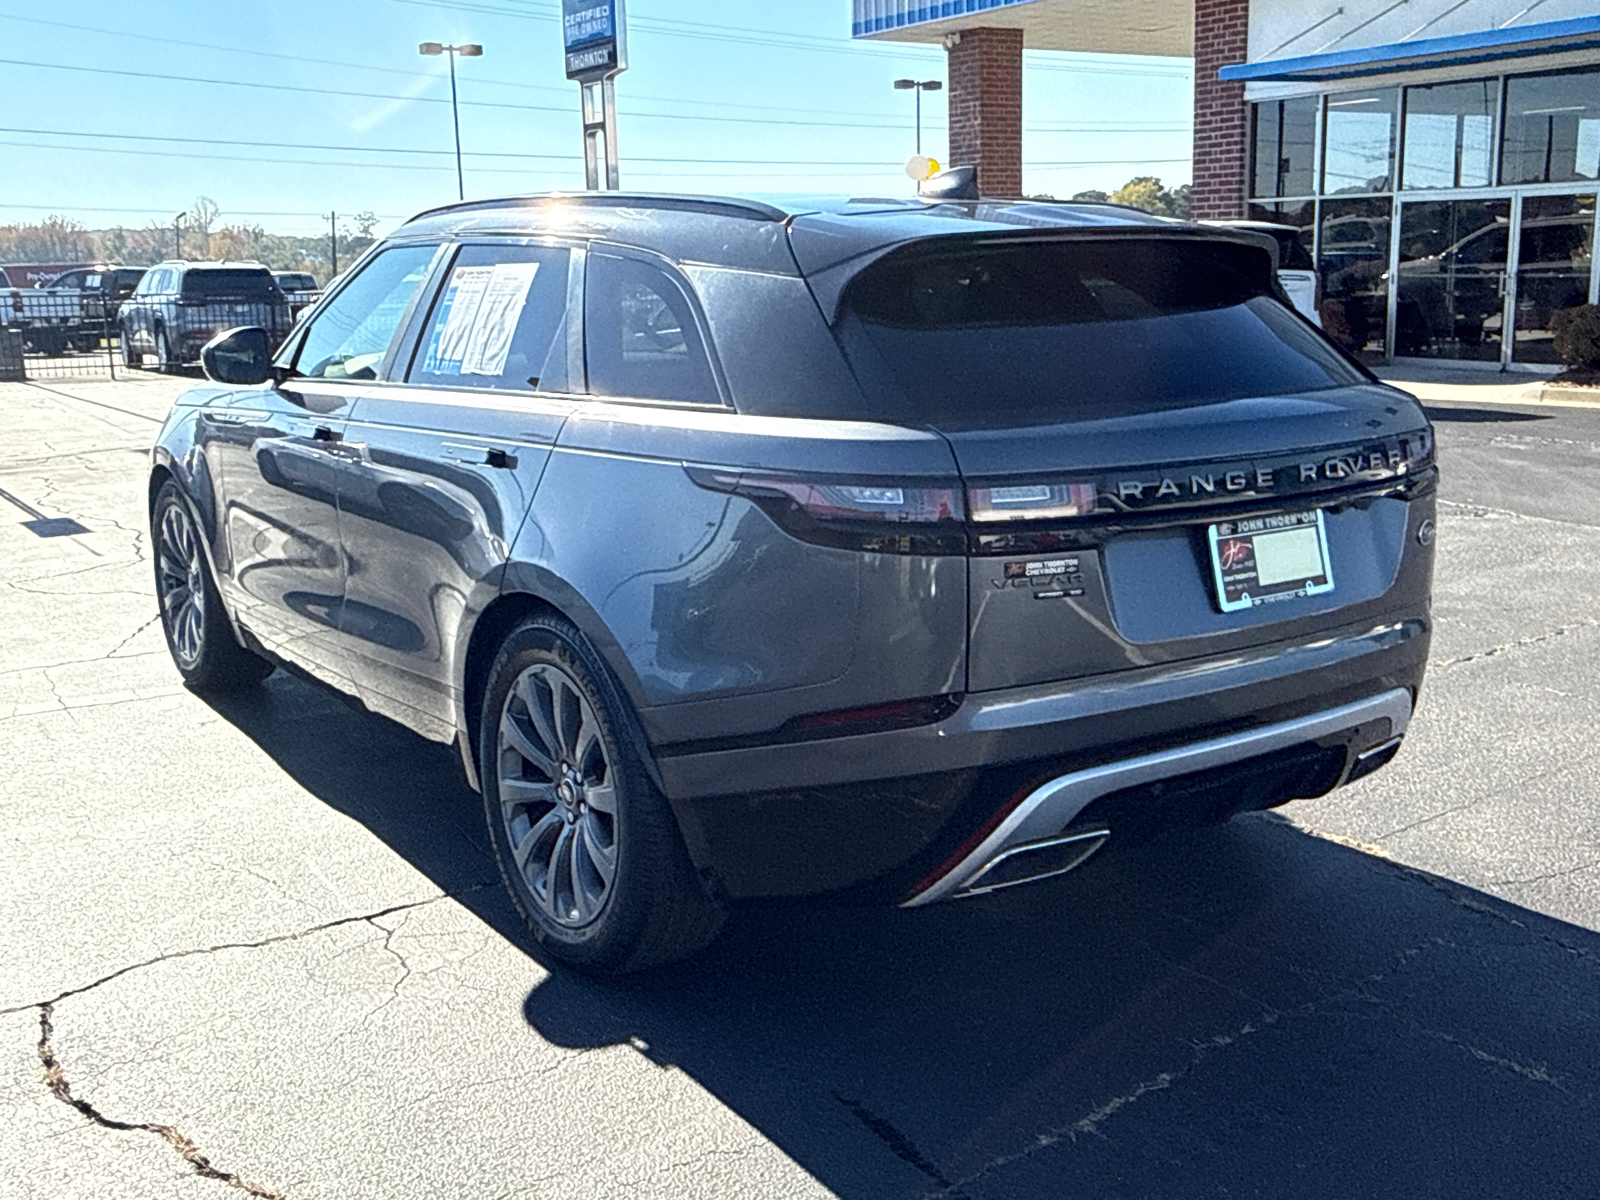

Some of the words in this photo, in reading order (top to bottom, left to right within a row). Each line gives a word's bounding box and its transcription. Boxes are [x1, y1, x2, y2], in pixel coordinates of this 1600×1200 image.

[565, 5, 610, 27] CERTIFIED
[570, 49, 609, 69] THORNTON
[1118, 467, 1274, 500] RANGE
[1300, 449, 1403, 482] ROVER
[1236, 518, 1265, 533] JOHN
[1025, 560, 1044, 570] JOHN
[1044, 558, 1079, 569] THORNTON
[1025, 567, 1066, 577] CHEVROLET
